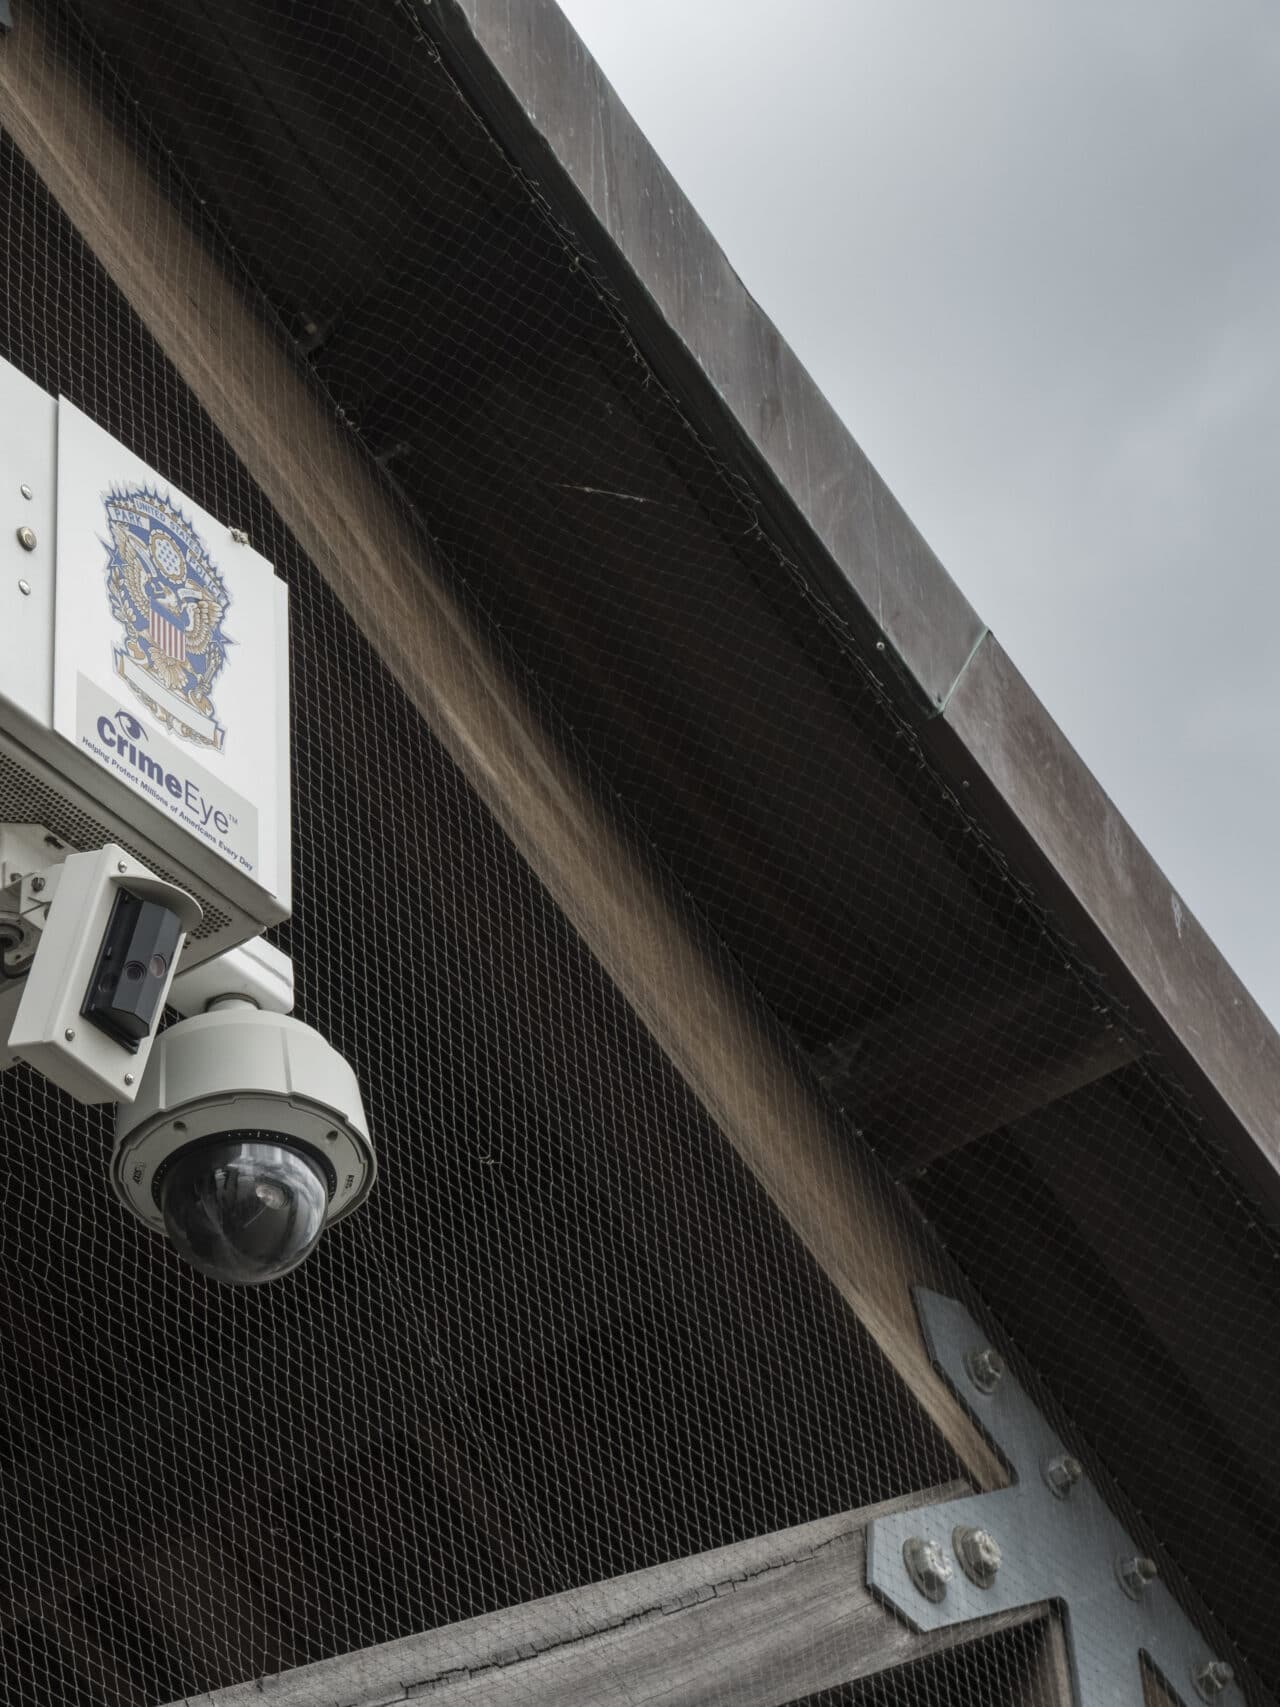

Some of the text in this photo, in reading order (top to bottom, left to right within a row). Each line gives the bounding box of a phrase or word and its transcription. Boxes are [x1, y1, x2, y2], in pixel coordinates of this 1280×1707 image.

[113, 509, 143, 527] PARK
[136, 500, 202, 554] UNITED STATES
[82, 736, 253, 871] Helping Protect Millions of Americans Every Day
